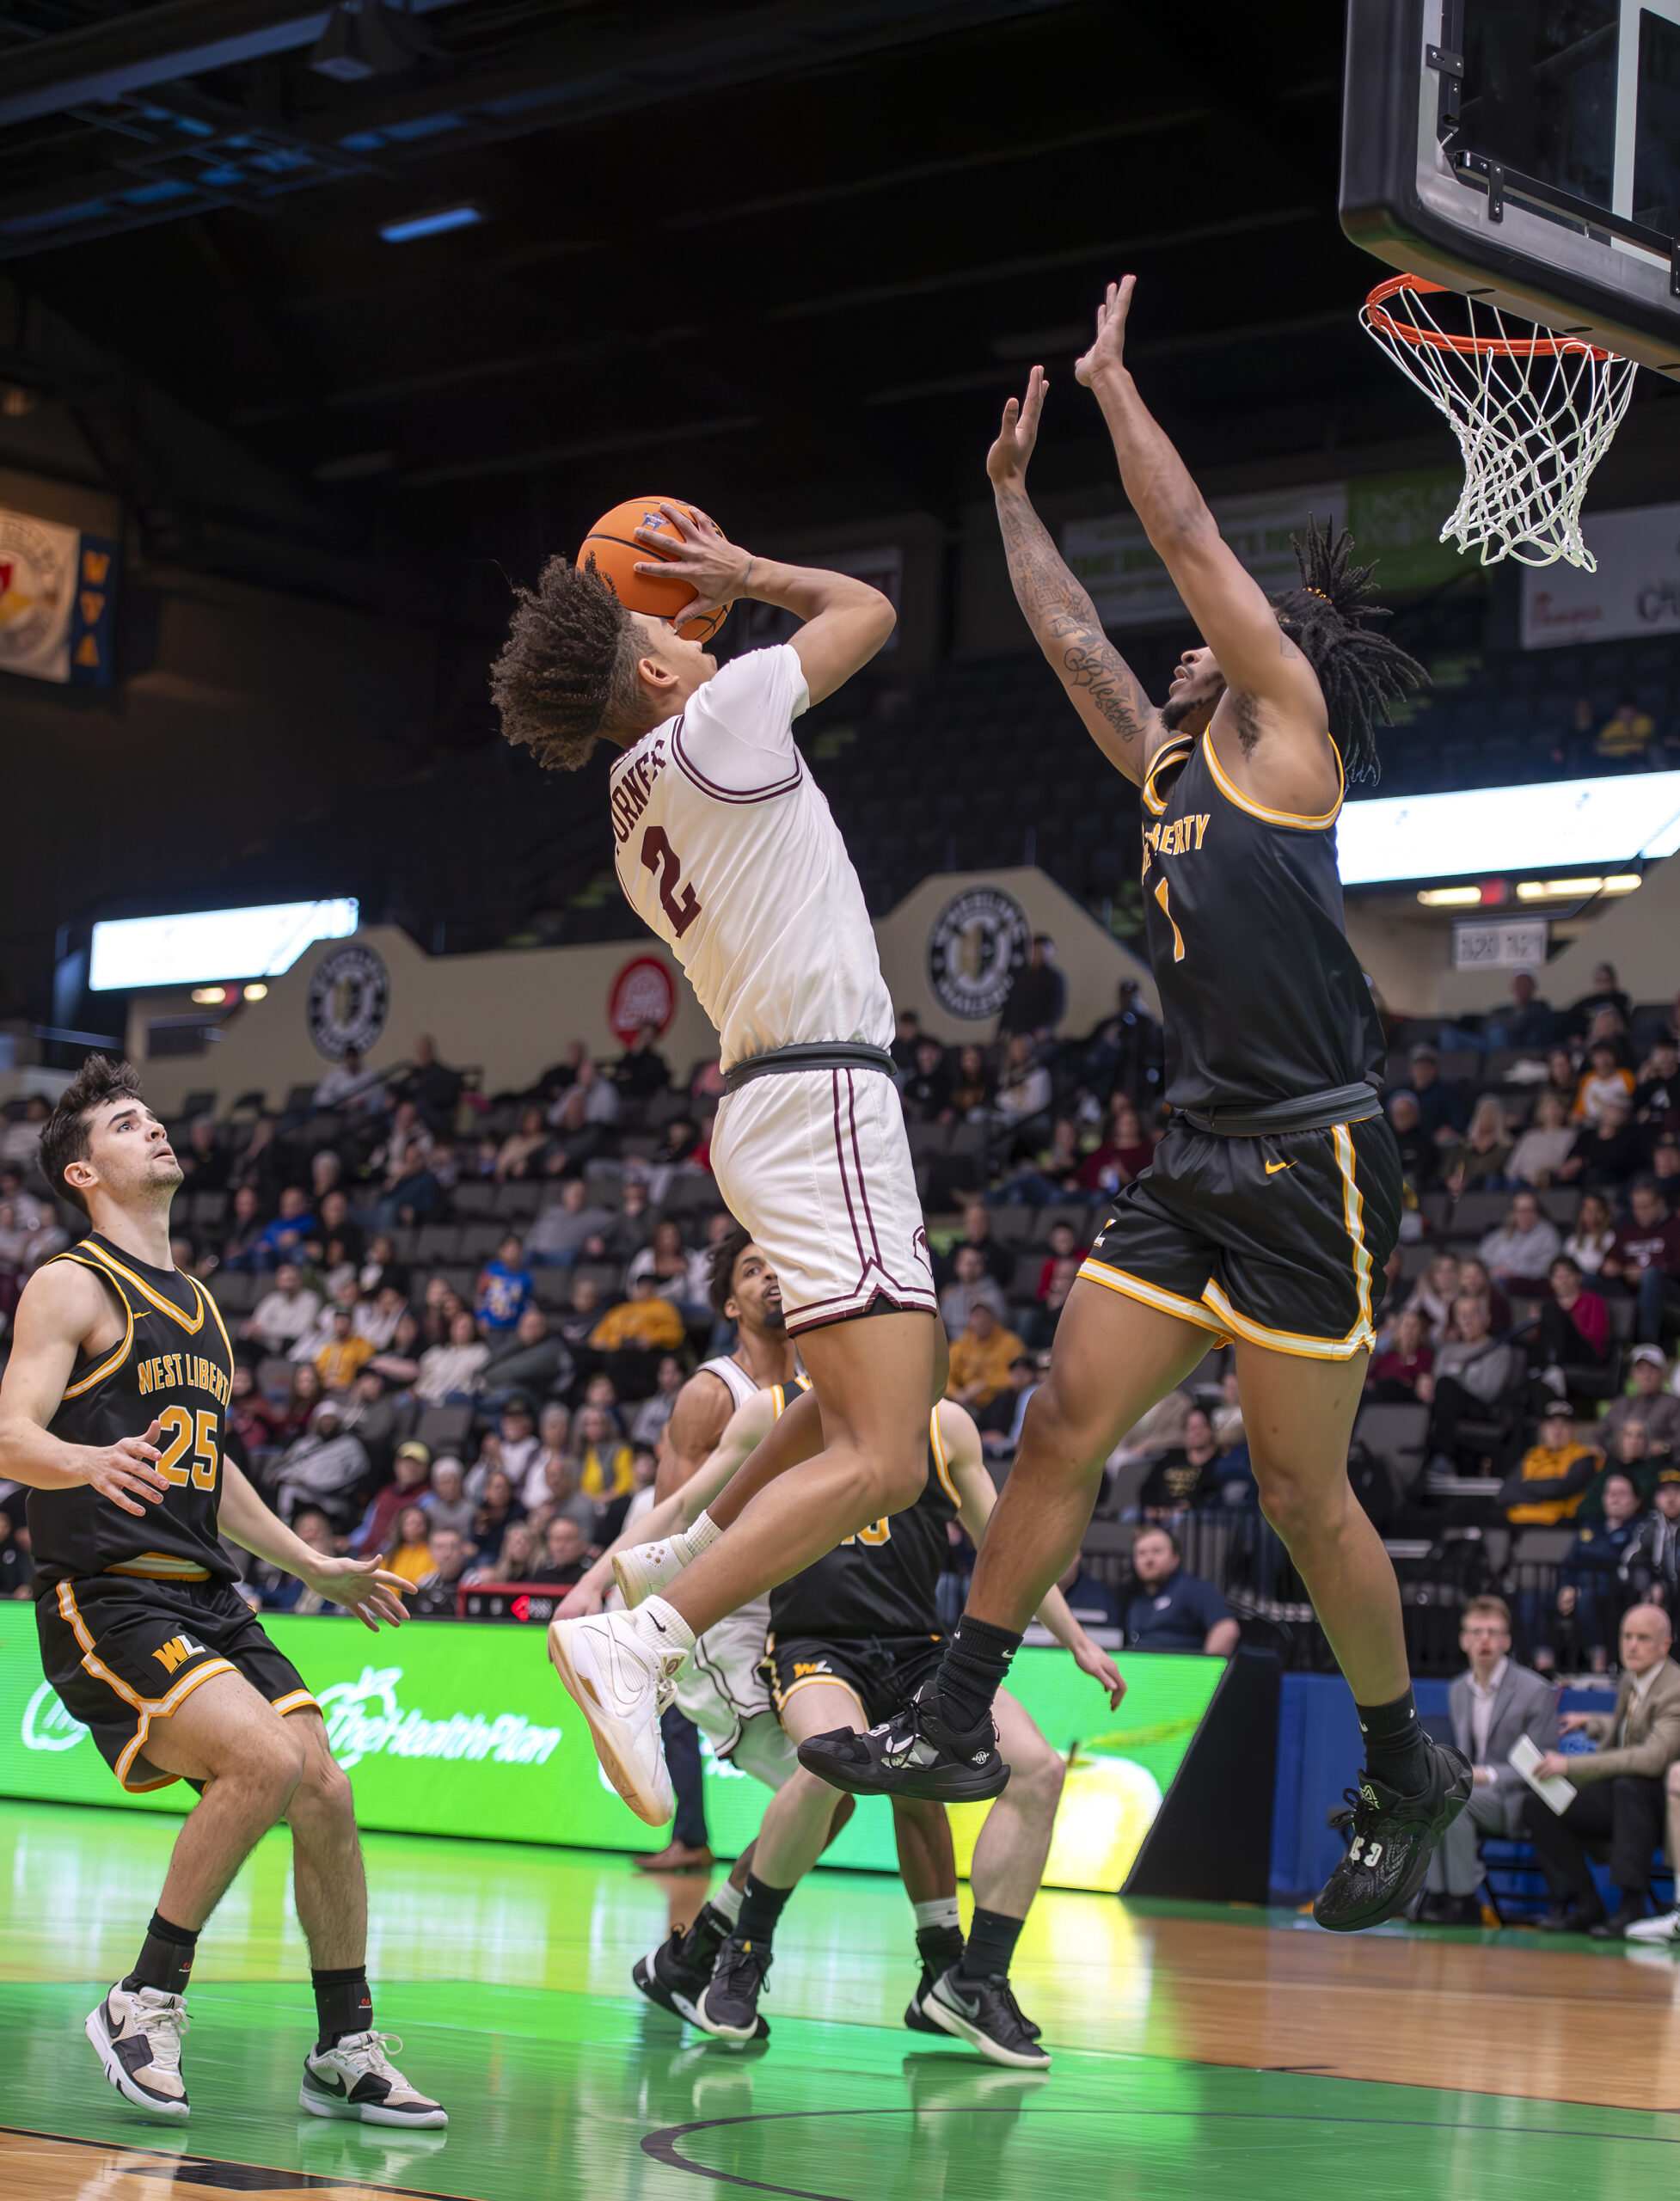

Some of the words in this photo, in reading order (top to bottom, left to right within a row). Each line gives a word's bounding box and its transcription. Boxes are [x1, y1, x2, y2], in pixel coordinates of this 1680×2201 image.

[611, 739, 667, 856] URNE
[1144, 814, 1211, 855] BERTY
[641, 825, 702, 939] 2
[1155, 876, 1185, 962] 1
[138, 1353, 183, 1395] WEST
[186, 1353, 230, 1407] LIBERT
[155, 1405, 218, 1493] 25
